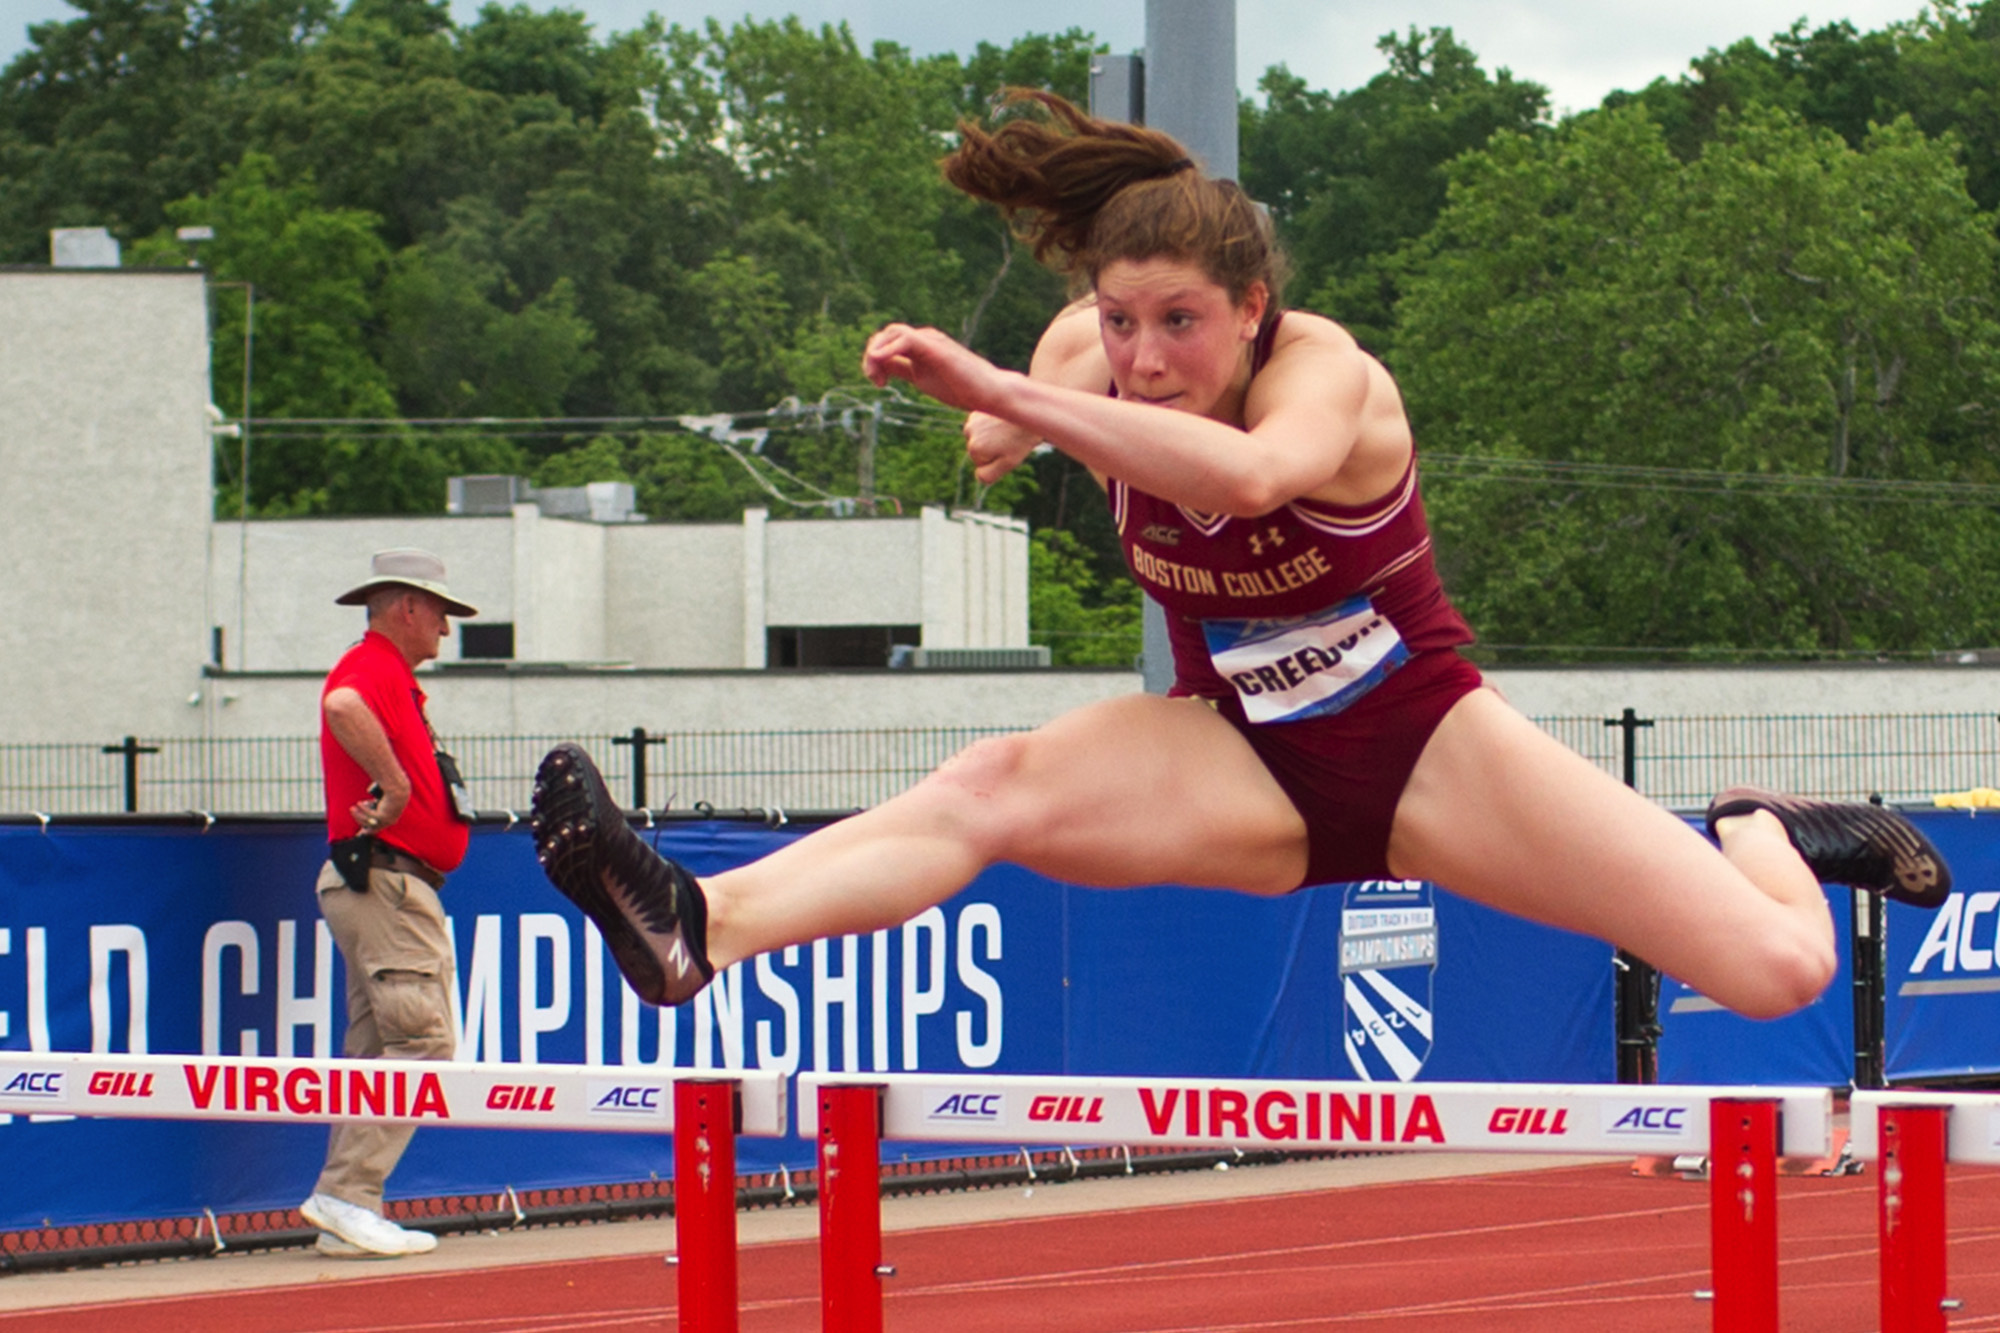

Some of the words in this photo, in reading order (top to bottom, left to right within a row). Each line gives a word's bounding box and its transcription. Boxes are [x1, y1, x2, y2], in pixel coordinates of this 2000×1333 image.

[1141, 526, 1181, 545] ACC
[1133, 543, 1217, 595] BOSTON
[1222, 547, 1332, 598] COLLEGE
[1230, 618, 1382, 696] CREEDO
[1342, 932, 1435, 967] CHAMPIONSHIPS
[1908, 891, 2000, 974] AC
[202, 903, 1001, 1079] CHMPINSHIPS
[4, 1072, 63, 1092] ACC
[87, 1071, 155, 1097] GILL
[183, 1064, 450, 1119] VIRGINIA
[485, 1085, 556, 1112] GILL
[597, 1087, 661, 1109] ACC
[934, 1094, 1001, 1115] ACC
[1028, 1095, 1104, 1123] GILL
[1137, 1087, 1446, 1144] VIRGINIA
[1488, 1107, 1568, 1135] GILL
[1613, 1107, 1687, 1129] ACC
